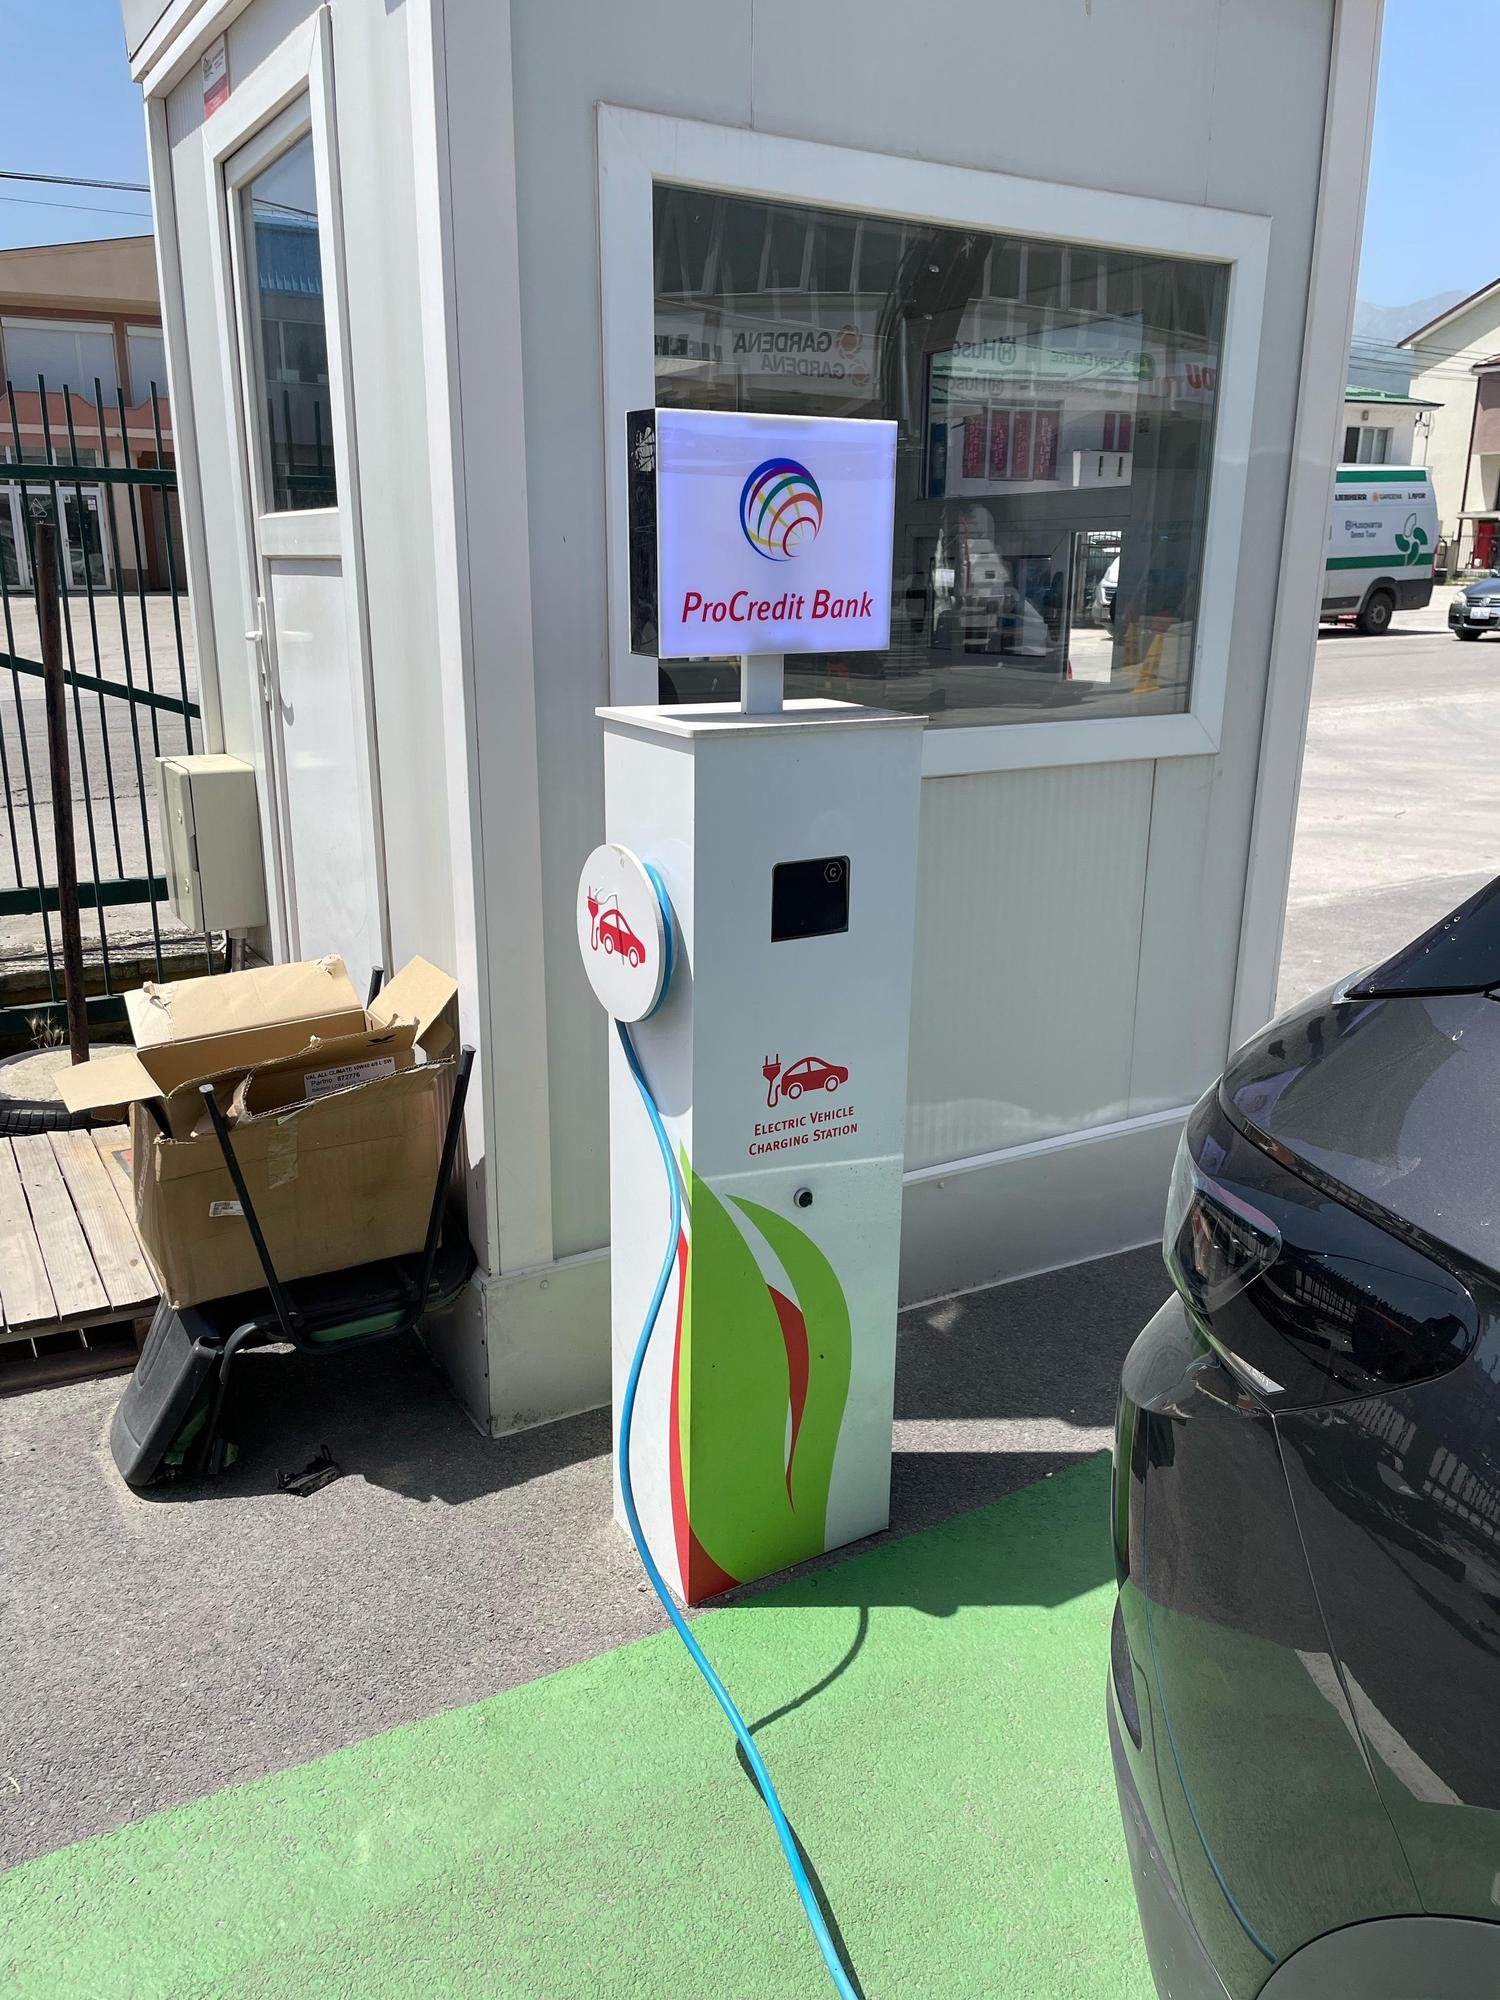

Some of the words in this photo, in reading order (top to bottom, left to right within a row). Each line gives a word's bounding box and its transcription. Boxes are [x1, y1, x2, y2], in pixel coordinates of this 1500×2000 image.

[681, 590, 804, 623] ProCredit
[811, 589, 874, 619] Bank
[318, 1072, 328, 1080] ALL
[328, 1066, 352, 1077] CLIMATE
[754, 1116, 807, 1136] ELECTRIC
[810, 1106, 854, 1124] VEHICLE
[749, 1134, 809, 1155] CHARGING
[813, 1123, 858, 1142] STATION
